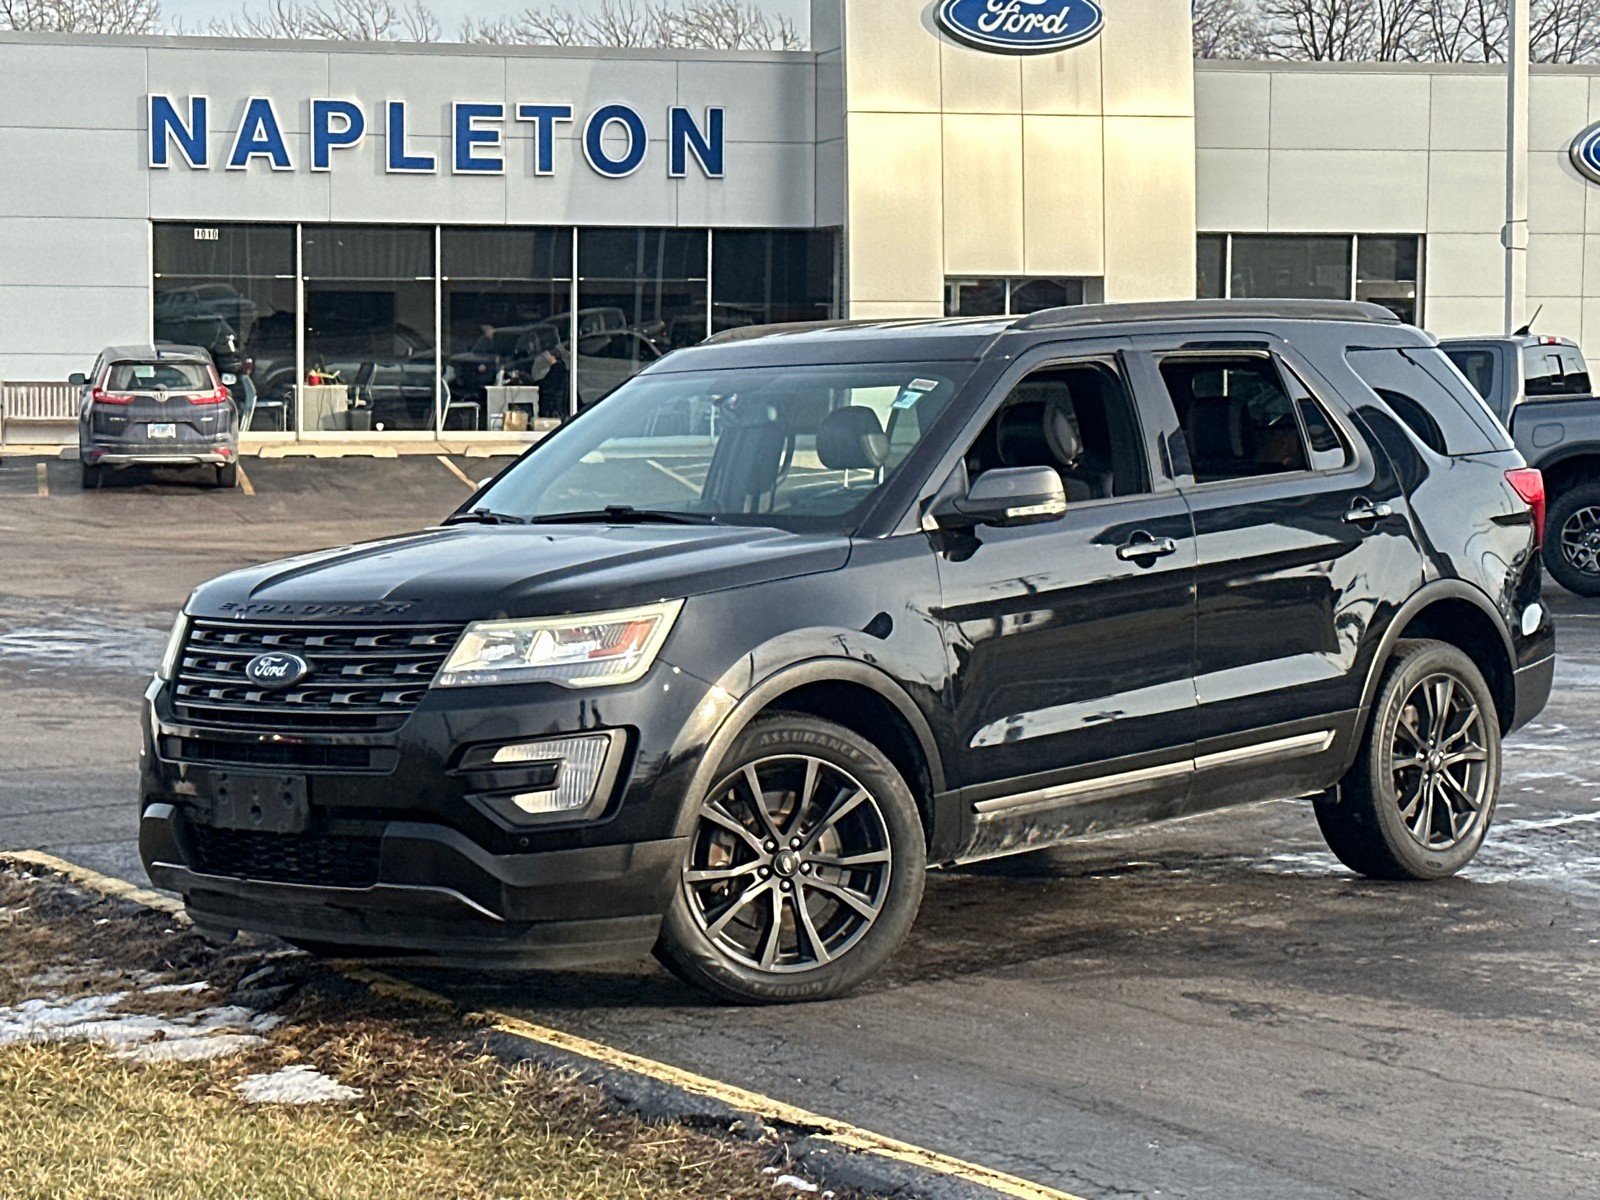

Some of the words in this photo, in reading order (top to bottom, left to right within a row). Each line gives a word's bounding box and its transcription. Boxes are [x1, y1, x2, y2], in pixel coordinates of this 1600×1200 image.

[977, 0, 1071, 35] Ford
[147, 92, 726, 179] NAPLETON
[196, 229, 218, 239] 1010
[218, 601, 412, 617] EXPLORER
[254, 656, 290, 677] Ford
[760, 730, 861, 760] ASSURANCE
